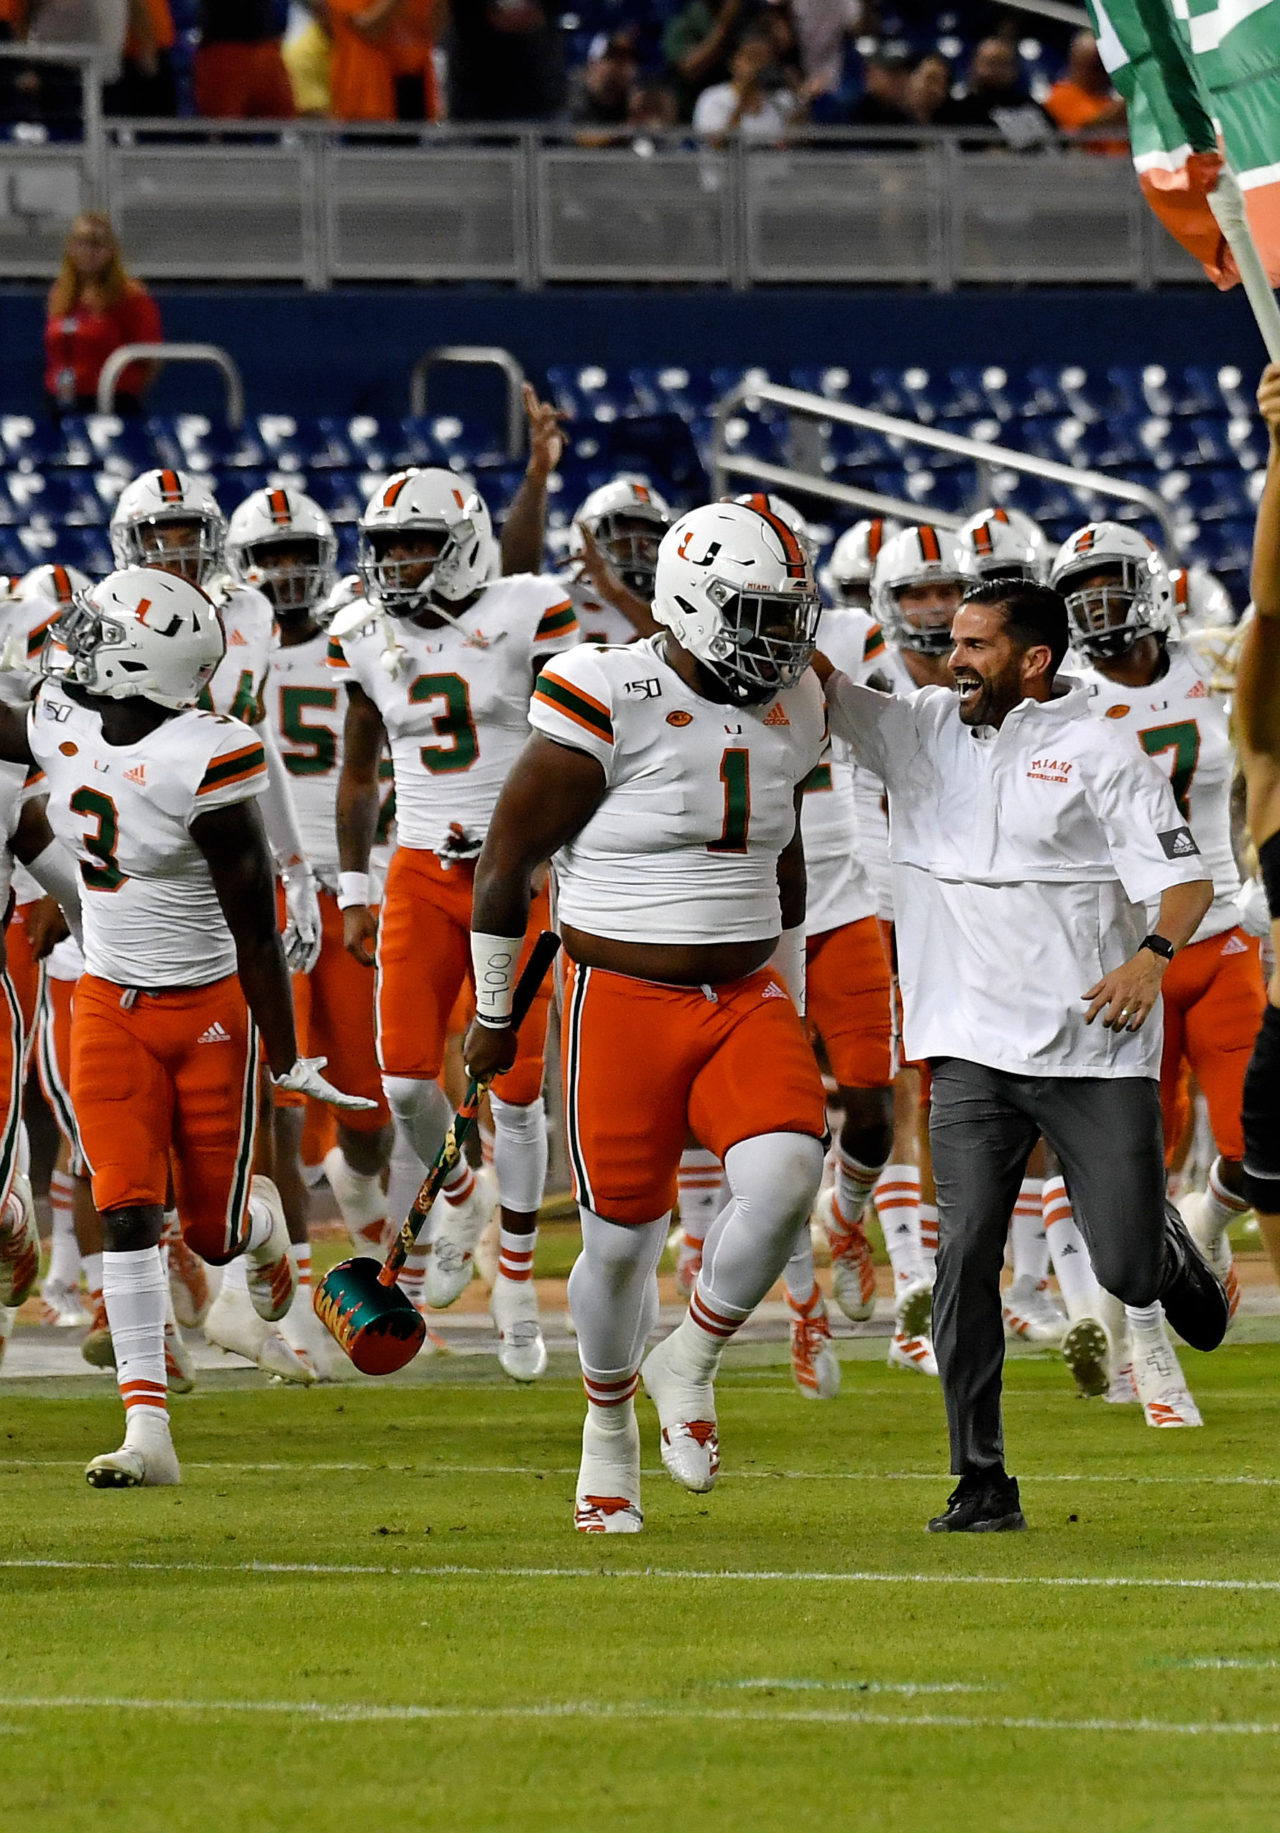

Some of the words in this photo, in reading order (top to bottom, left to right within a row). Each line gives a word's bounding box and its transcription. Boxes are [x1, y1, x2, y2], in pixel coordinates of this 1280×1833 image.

[677, 532, 722, 567] U
[747, 582, 771, 591] MIAMI
[408, 672, 480, 775] 3
[623, 678, 662, 701] 150
[706, 748, 751, 854] 1
[1032, 759, 1073, 775] MIAMI
[1136, 718, 1202, 827] 7
[69, 785, 129, 893] 3
